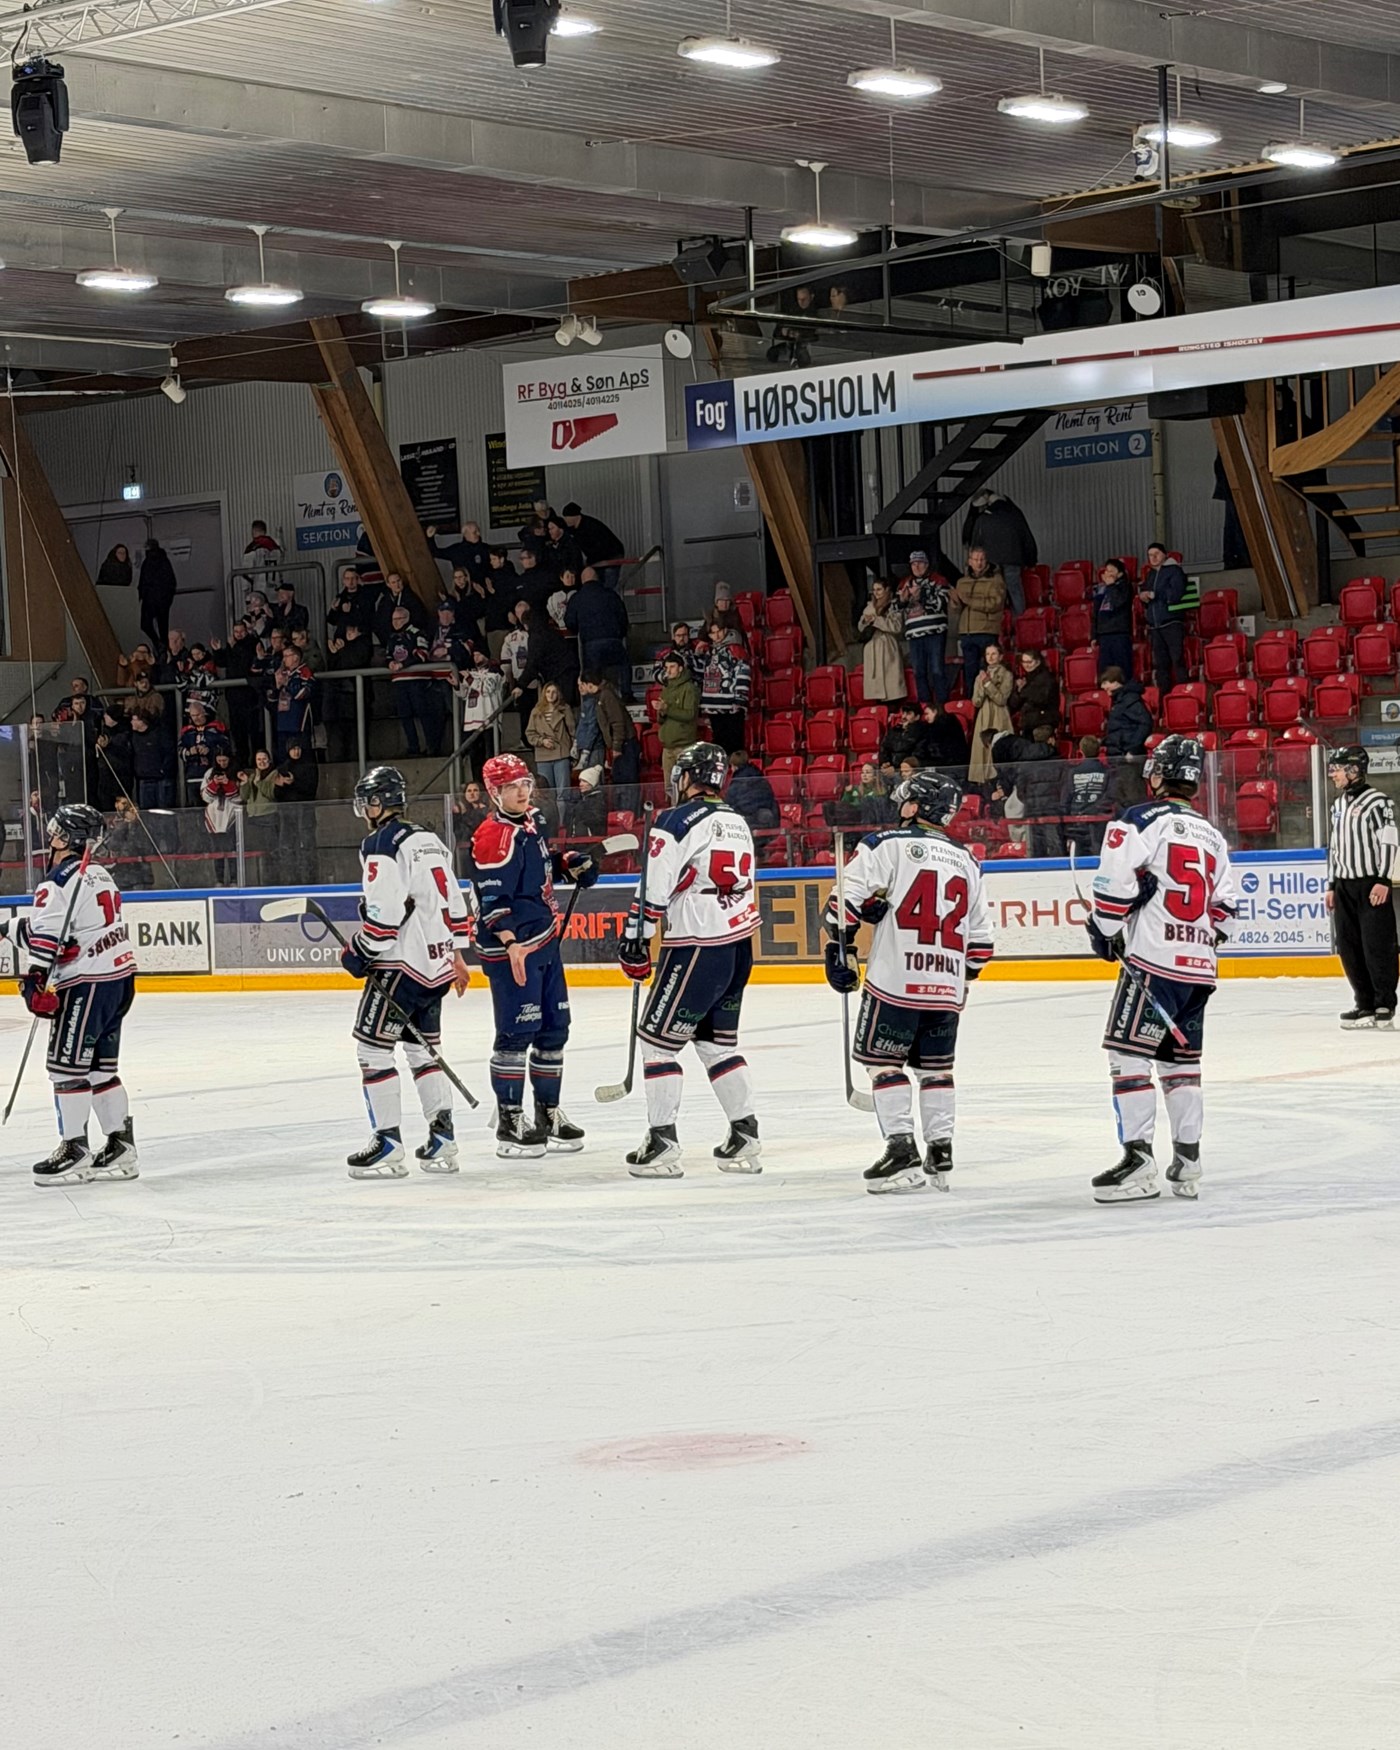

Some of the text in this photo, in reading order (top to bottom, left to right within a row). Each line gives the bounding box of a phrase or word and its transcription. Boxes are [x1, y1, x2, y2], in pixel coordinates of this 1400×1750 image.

[518, 368, 650, 401] RF Byg & Søn ApS
[696, 399, 726, 430] Fog
[743, 370, 897, 432] HØRSHOLM
[1055, 403, 1136, 432] Nemt og Rent
[1054, 437, 1142, 460] SEKTION 2
[298, 498, 359, 521] Nemt og Ren
[302, 527, 351, 545] SEKTION
[367, 862, 379, 882] 5
[895, 868, 969, 954] 42
[988, 899, 1092, 929] RHO
[1235, 898, 1330, 921] El-Servi
[138, 921, 204, 948] BANK
[1238, 931, 1269, 944] 4826
[1273, 930, 1304, 943] 2045
[266, 948, 305, 963] UNIK
[650, 971, 679, 1024] Conradsen
[63, 1004, 82, 1056] Conradsen
